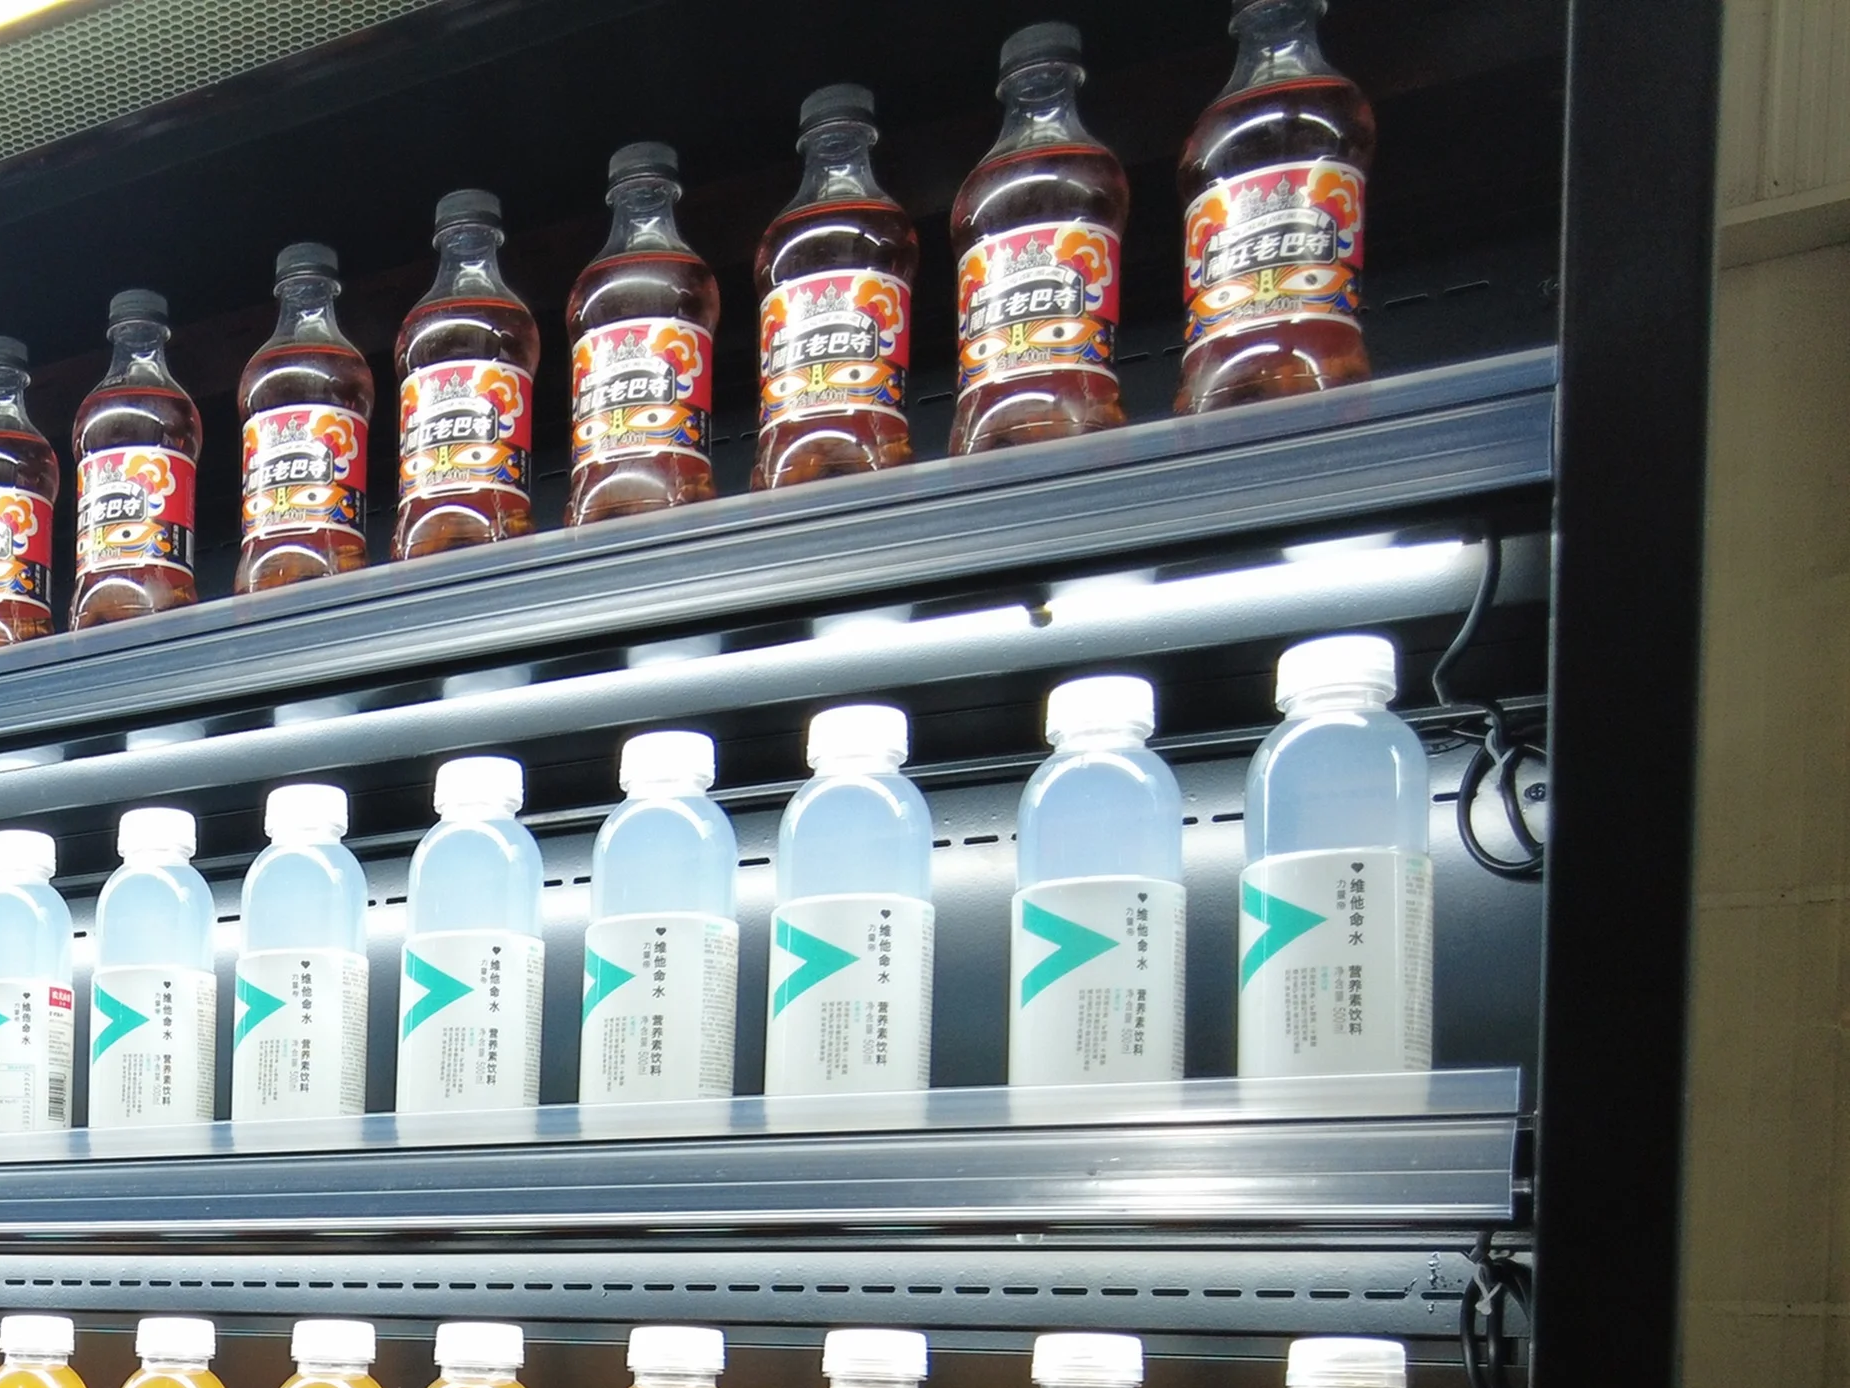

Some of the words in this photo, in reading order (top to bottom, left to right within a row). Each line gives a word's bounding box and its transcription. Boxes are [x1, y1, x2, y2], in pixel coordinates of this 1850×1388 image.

[1137, 908, 1148, 970] 维他命水
[1349, 879, 1365, 946] 维他命水
[652, 941, 667, 999] 维他命水
[878, 924, 891, 984] 维他命水
[301, 973, 313, 1025] 维他命水
[489, 959, 501, 1012] 维他命水
[1349, 965, 1362, 1035] 营养素饮料
[162, 992, 173, 1041] 维他命水
[650, 1014, 663, 1076] 营养素饮料
[876, 1002, 889, 1066] 营养素饮料
[1133, 989, 1147, 1056] 营养素饮料
[162, 1054, 172, 1105] 营养素饮料
[300, 1039, 311, 1092] 营养素饮料
[487, 1028, 498, 1086] 营养素饮料
